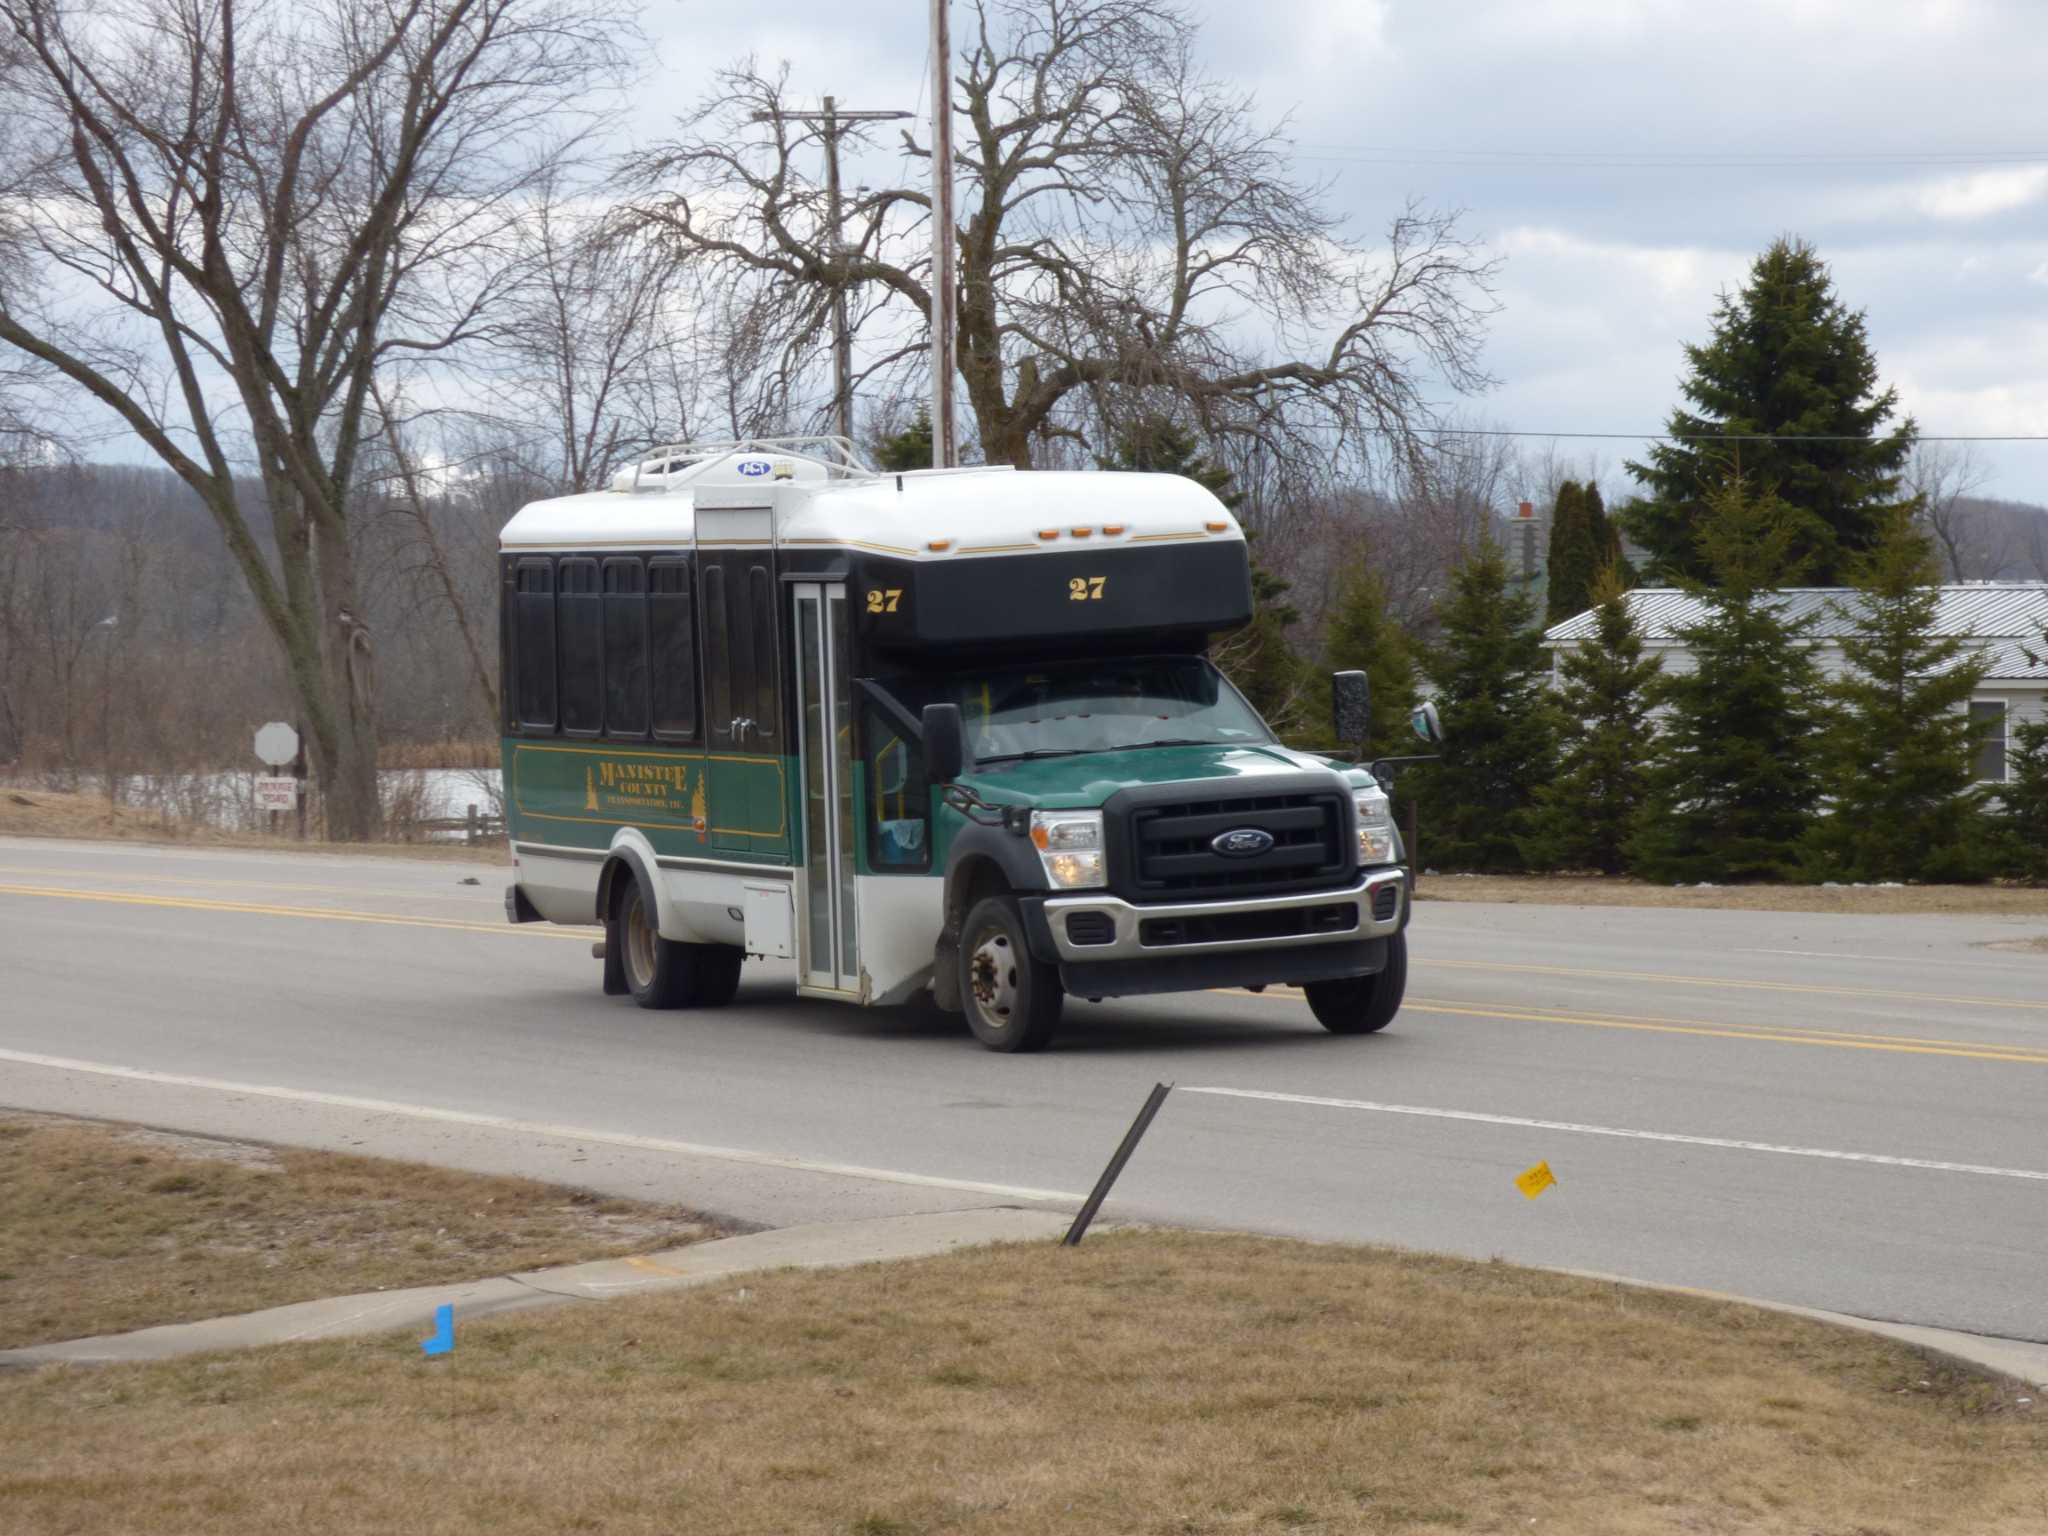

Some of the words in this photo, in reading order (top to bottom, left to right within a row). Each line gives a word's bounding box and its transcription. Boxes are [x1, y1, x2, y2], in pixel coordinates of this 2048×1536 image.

[1069, 576, 1107, 601] 27
[866, 589, 902, 614] 27
[600, 762, 687, 791] MANISTEE
[618, 783, 667, 796] COUNTY
